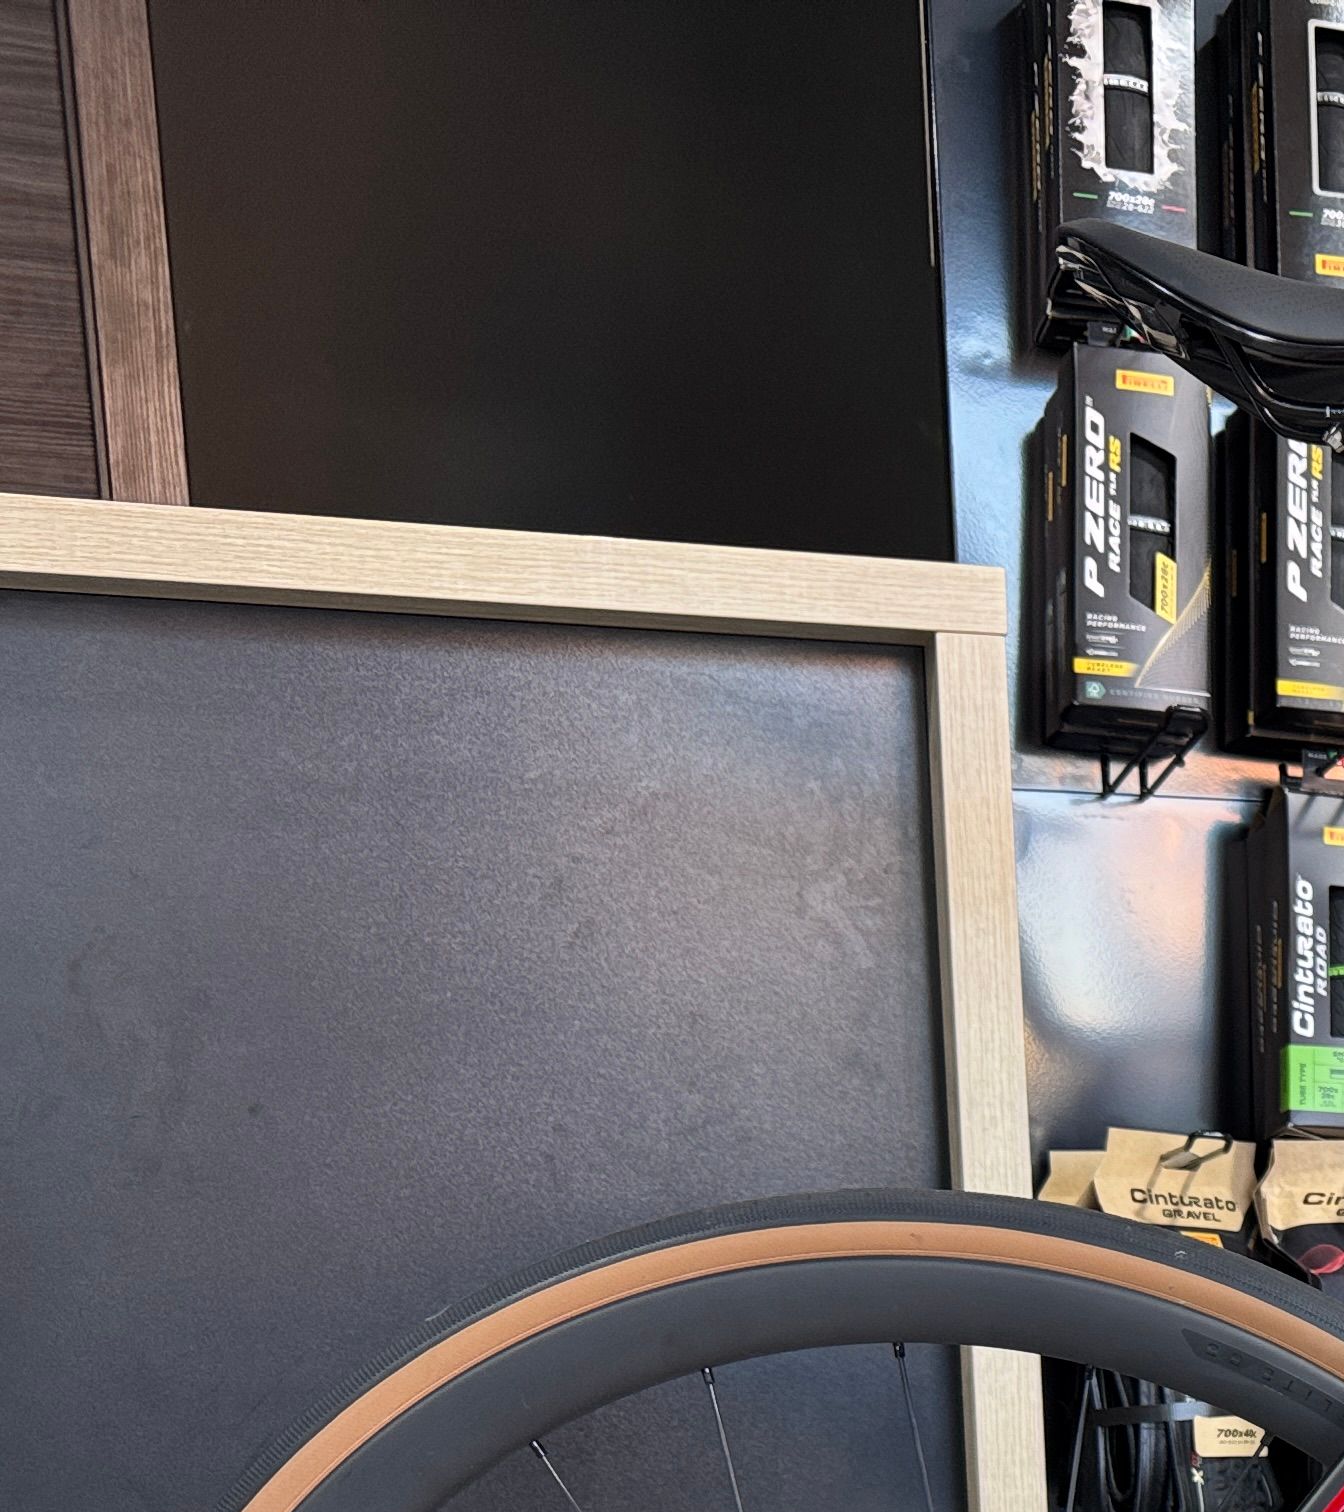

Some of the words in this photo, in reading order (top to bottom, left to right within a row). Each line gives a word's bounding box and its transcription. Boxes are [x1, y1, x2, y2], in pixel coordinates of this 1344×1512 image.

[1121, 374, 1169, 391] PIRELLI
[1108, 435, 1122, 473] RS
[1310, 446, 1324, 480] RS
[1085, 407, 1104, 555] ZERO
[1109, 496, 1121, 573] RACE
[1310, 504, 1323, 578] RACE
[1085, 564, 1104, 598] P
[1287, 564, 1307, 602] P
[1086, 620, 1147, 632] PERFORMANCE
[1293, 880, 1315, 1039] Cinturato
[1317, 926, 1329, 997] ROAD
[1130, 1188, 1237, 1212] Cinturato
[1162, 1208, 1222, 1223] GRAVEL
